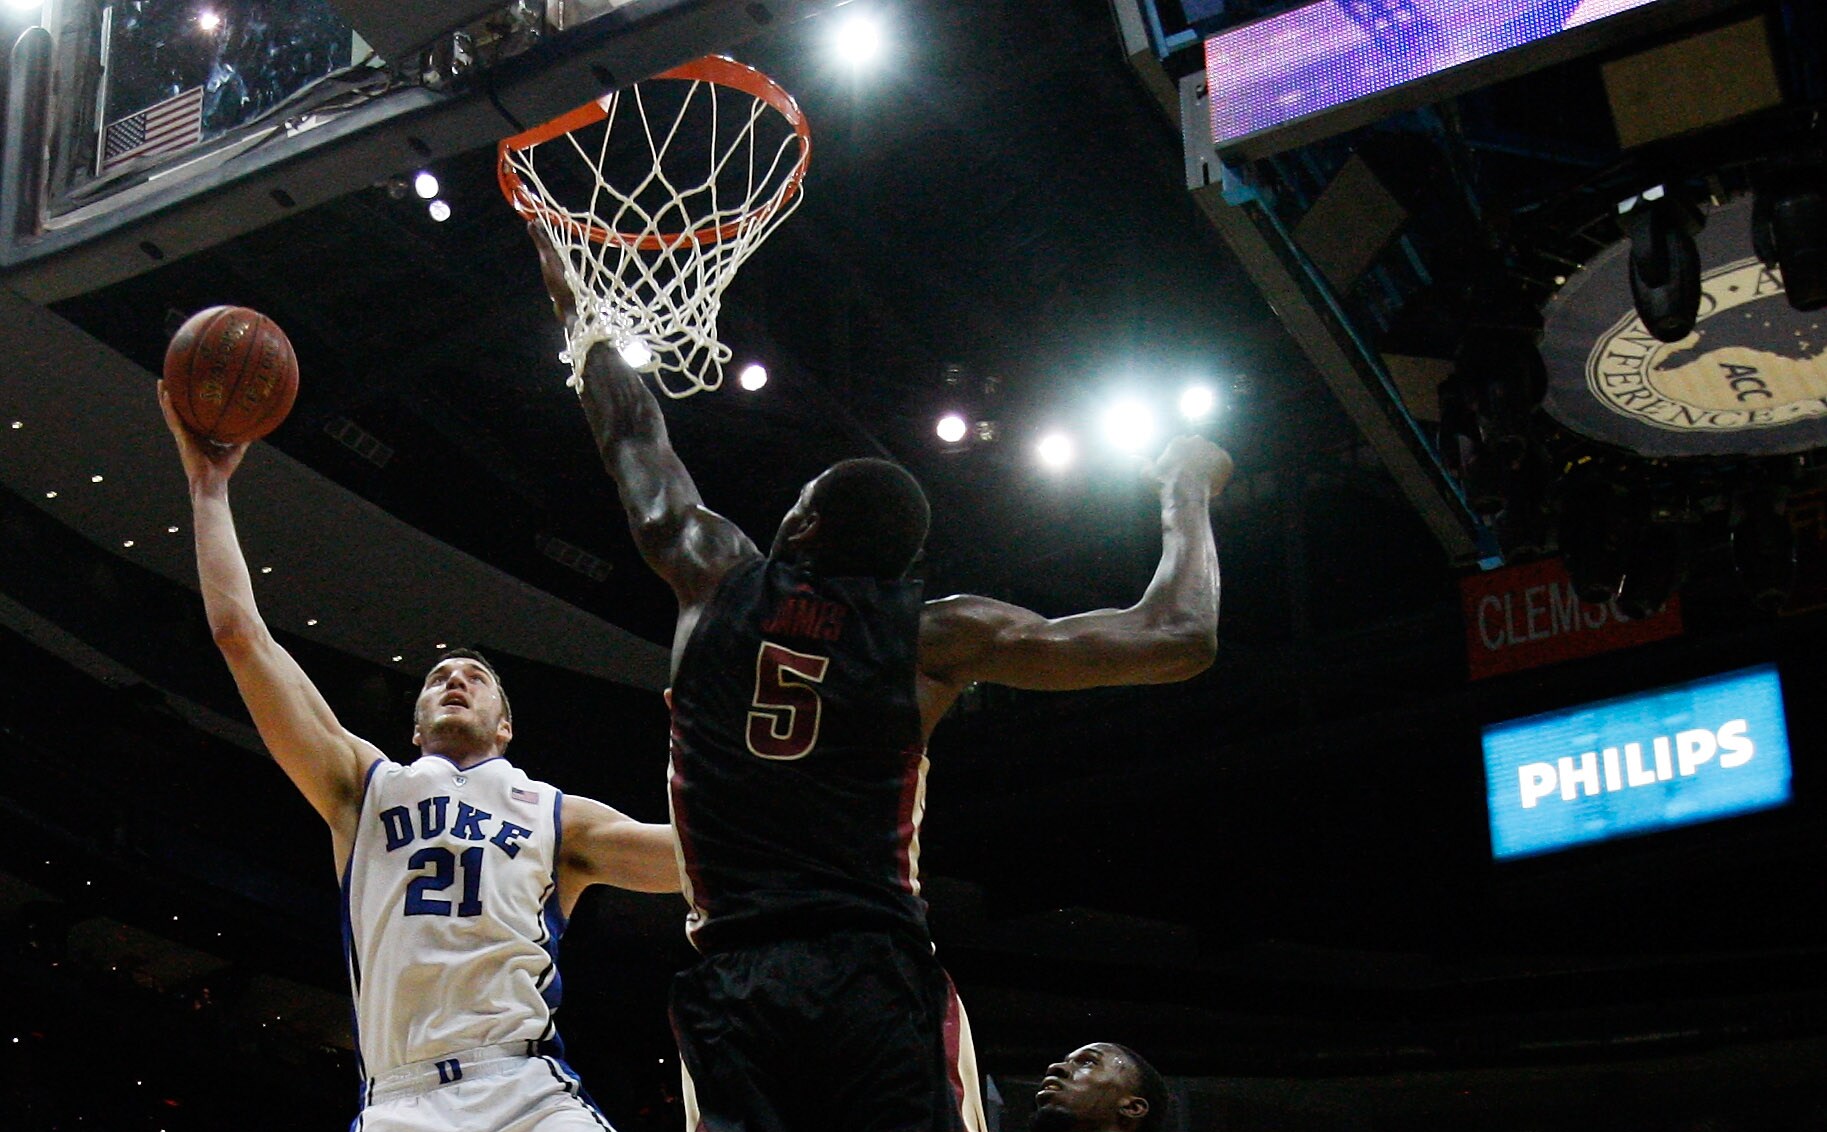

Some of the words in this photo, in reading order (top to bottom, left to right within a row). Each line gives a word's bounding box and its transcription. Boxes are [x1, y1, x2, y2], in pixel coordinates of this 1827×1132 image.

[1719, 362, 1774, 402] ACC
[745, 640, 830, 761] 5
[1517, 718, 1756, 809] PHILIPS
[379, 796, 533, 860] DUKE
[404, 846, 485, 918] 21
